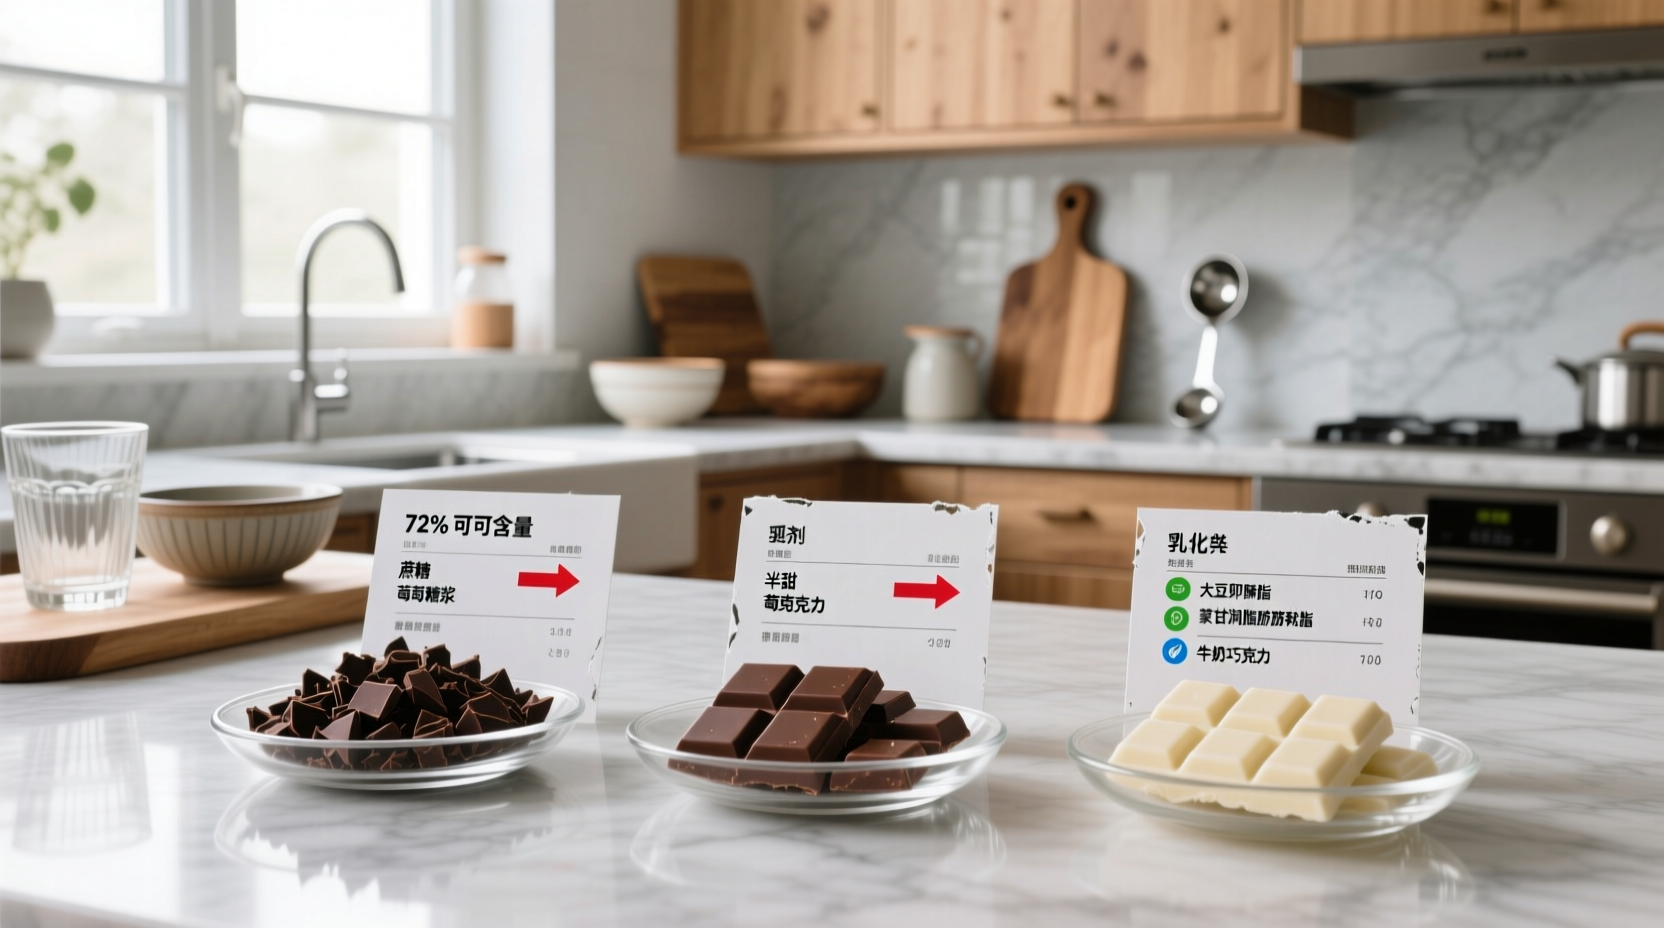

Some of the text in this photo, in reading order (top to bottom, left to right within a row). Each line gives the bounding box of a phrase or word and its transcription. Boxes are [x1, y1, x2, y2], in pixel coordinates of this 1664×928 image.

[405, 514, 533, 538] 72% 可可含量
[764, 571, 798, 591] 半甜
[1196, 644, 1271, 665] 牛奶巧克力
